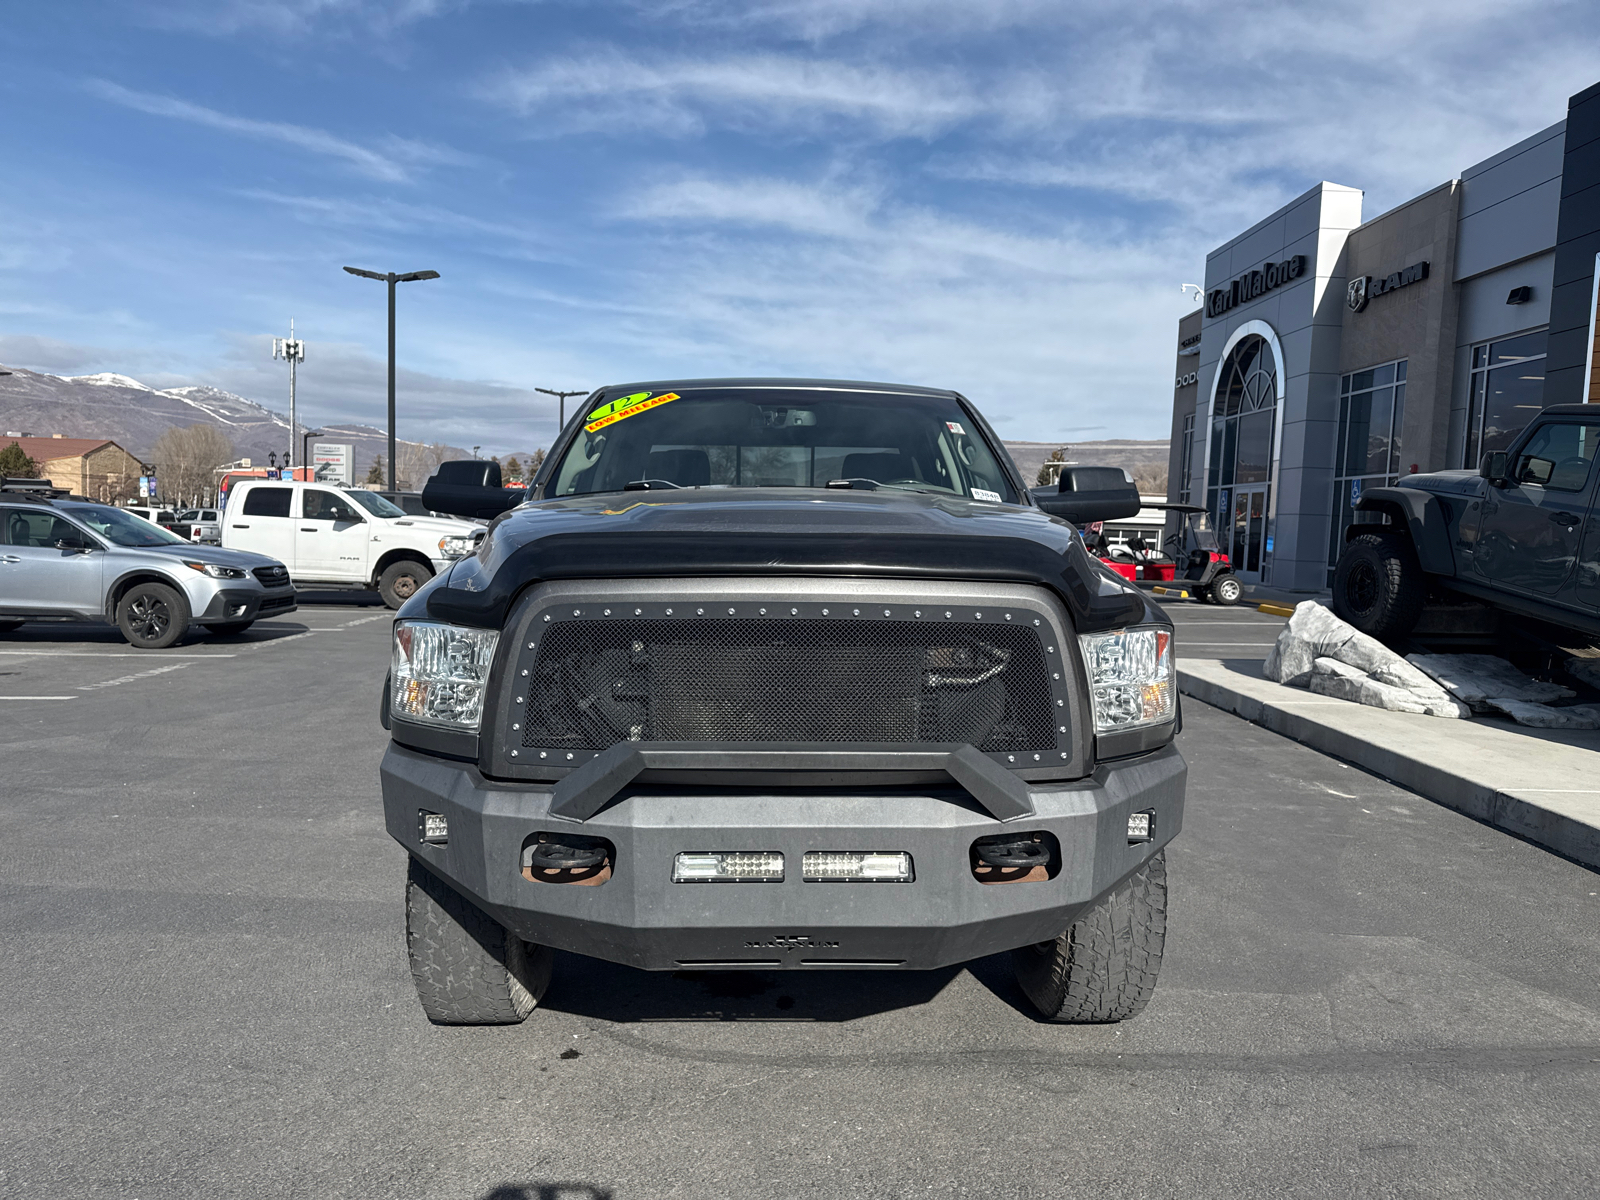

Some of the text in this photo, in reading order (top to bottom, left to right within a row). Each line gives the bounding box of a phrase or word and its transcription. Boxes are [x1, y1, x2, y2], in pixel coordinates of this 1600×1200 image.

[1206, 255, 1303, 318] Karl Malone
[1368, 261, 1427, 298] RAM
[588, 394, 676, 431] LOW MILEAGE
[609, 397, 633, 413] 12
